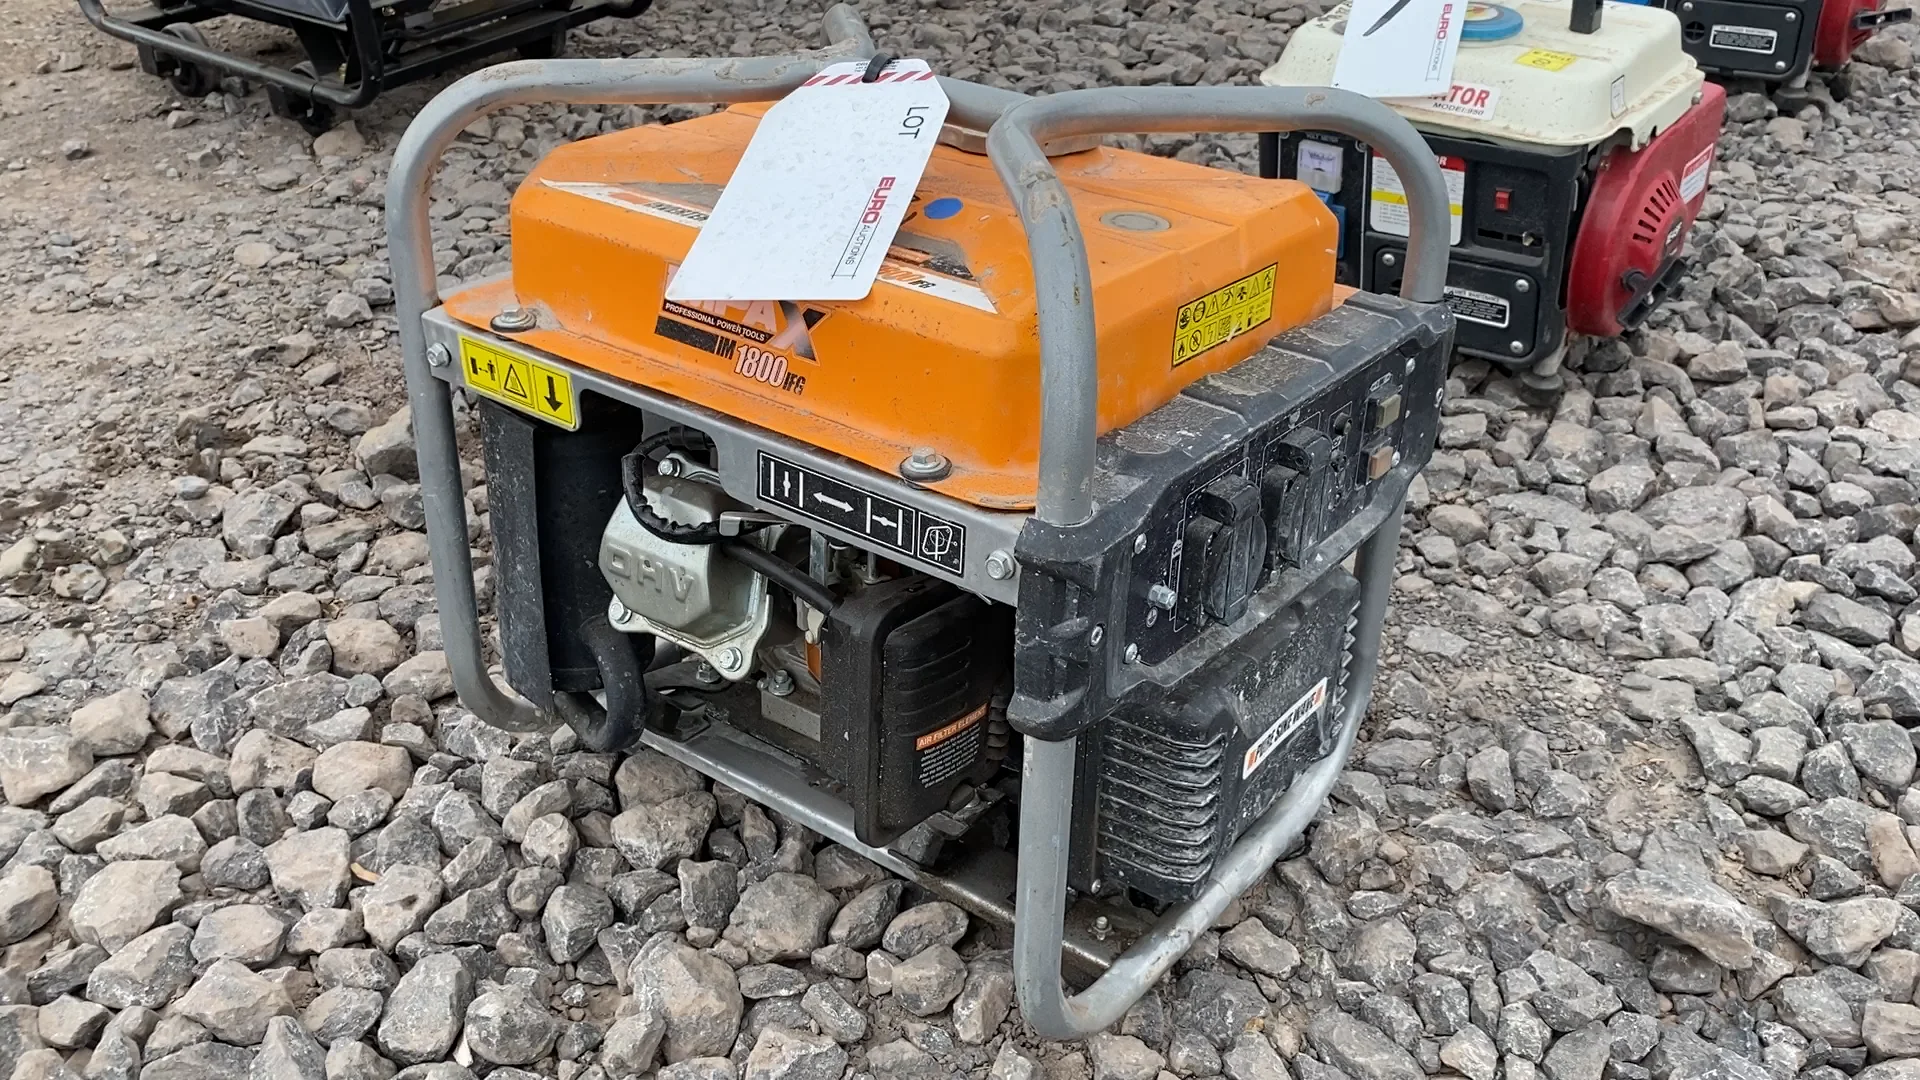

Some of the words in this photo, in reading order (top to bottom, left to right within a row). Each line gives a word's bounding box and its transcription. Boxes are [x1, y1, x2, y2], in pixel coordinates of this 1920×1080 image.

[1437, 4, 1453, 40] EURO
[898, 106, 930, 139] LOT
[862, 176, 896, 224] EURO
[844, 224, 872, 265] AUCTIONS
[664, 302, 716, 327] PROFESSIONAL
[716, 318, 743, 336] POWER
[742, 328, 766, 342] TOOLS
[606, 543, 696, 604] OHV
[919, 735, 933, 747] AIR
[933, 725, 958, 742] FILTER
